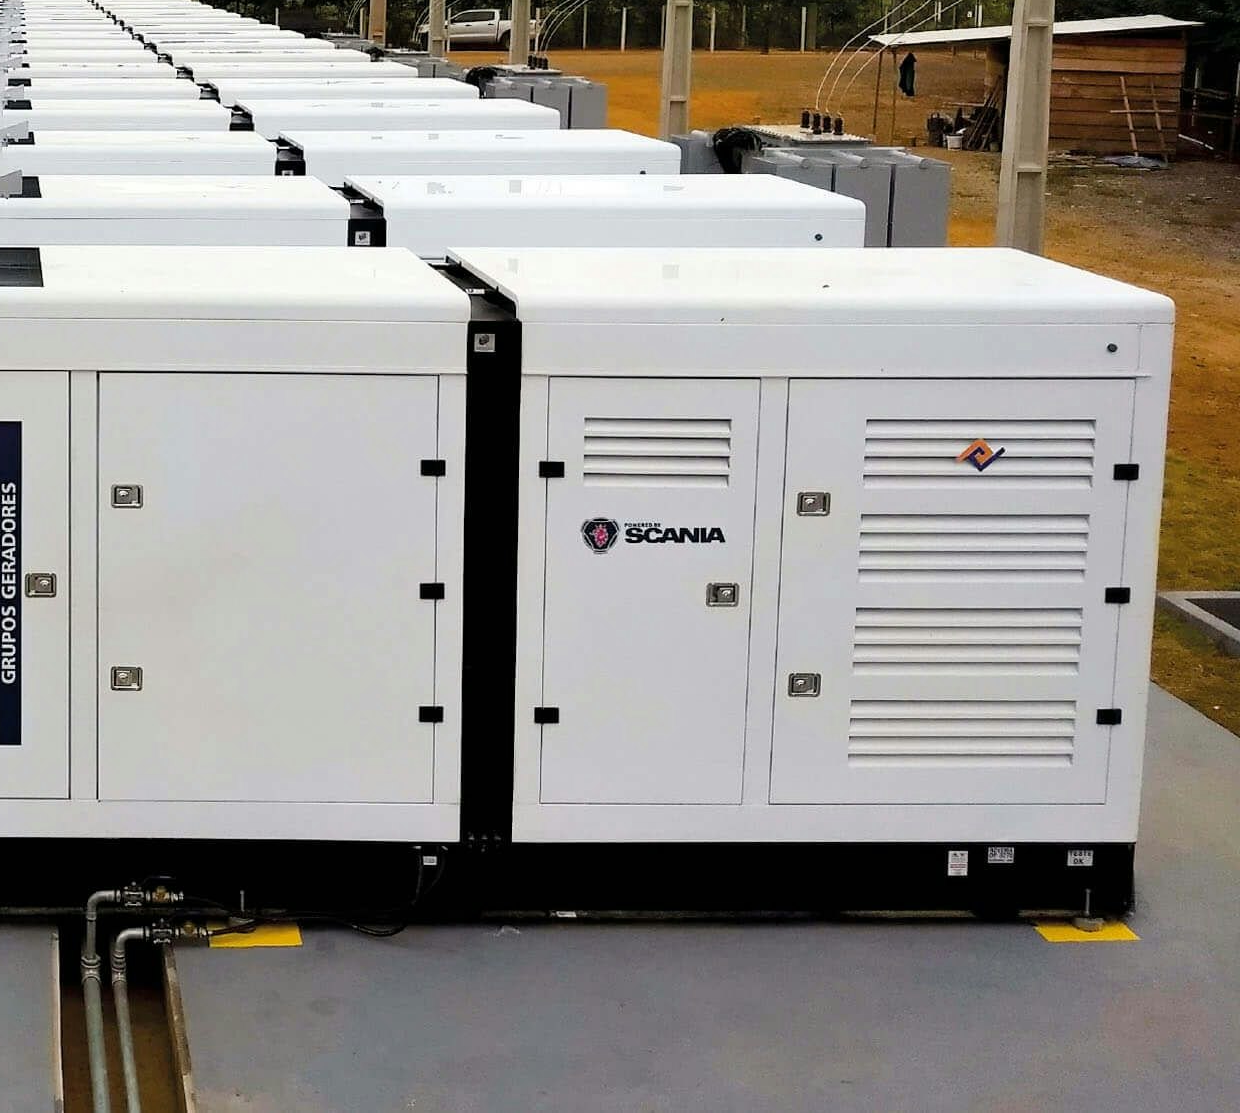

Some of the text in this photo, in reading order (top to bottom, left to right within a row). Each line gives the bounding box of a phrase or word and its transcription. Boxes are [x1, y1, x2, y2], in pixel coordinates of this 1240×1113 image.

[0, 481, 17, 685] GRUPOS GERADORES
[624, 527, 726, 544] SCANIA
